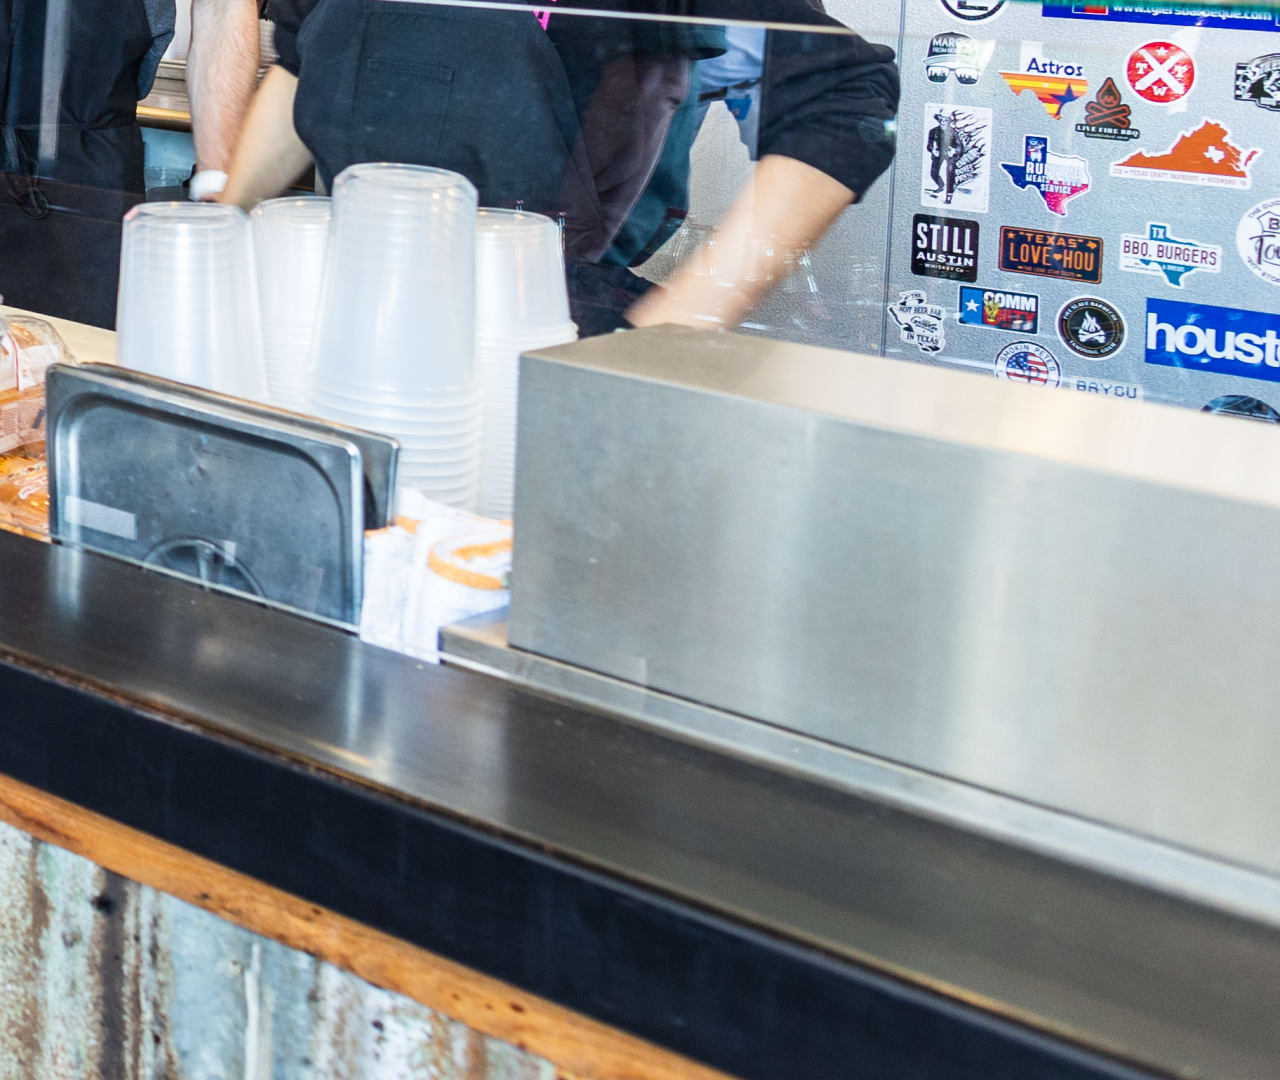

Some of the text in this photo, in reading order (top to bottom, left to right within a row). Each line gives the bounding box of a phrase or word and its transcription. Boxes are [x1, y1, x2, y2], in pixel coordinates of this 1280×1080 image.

[1026, 57, 1083, 77] Astros
[917, 223, 974, 255] STILL
[916, 252, 973, 267] AUSTIN
[1009, 242, 1052, 266] LOVE
[1063, 250, 1094, 272] HOU
[1157, 244, 1217, 266] BURGERS
[1000, 344, 1030, 362] SMOKIN
